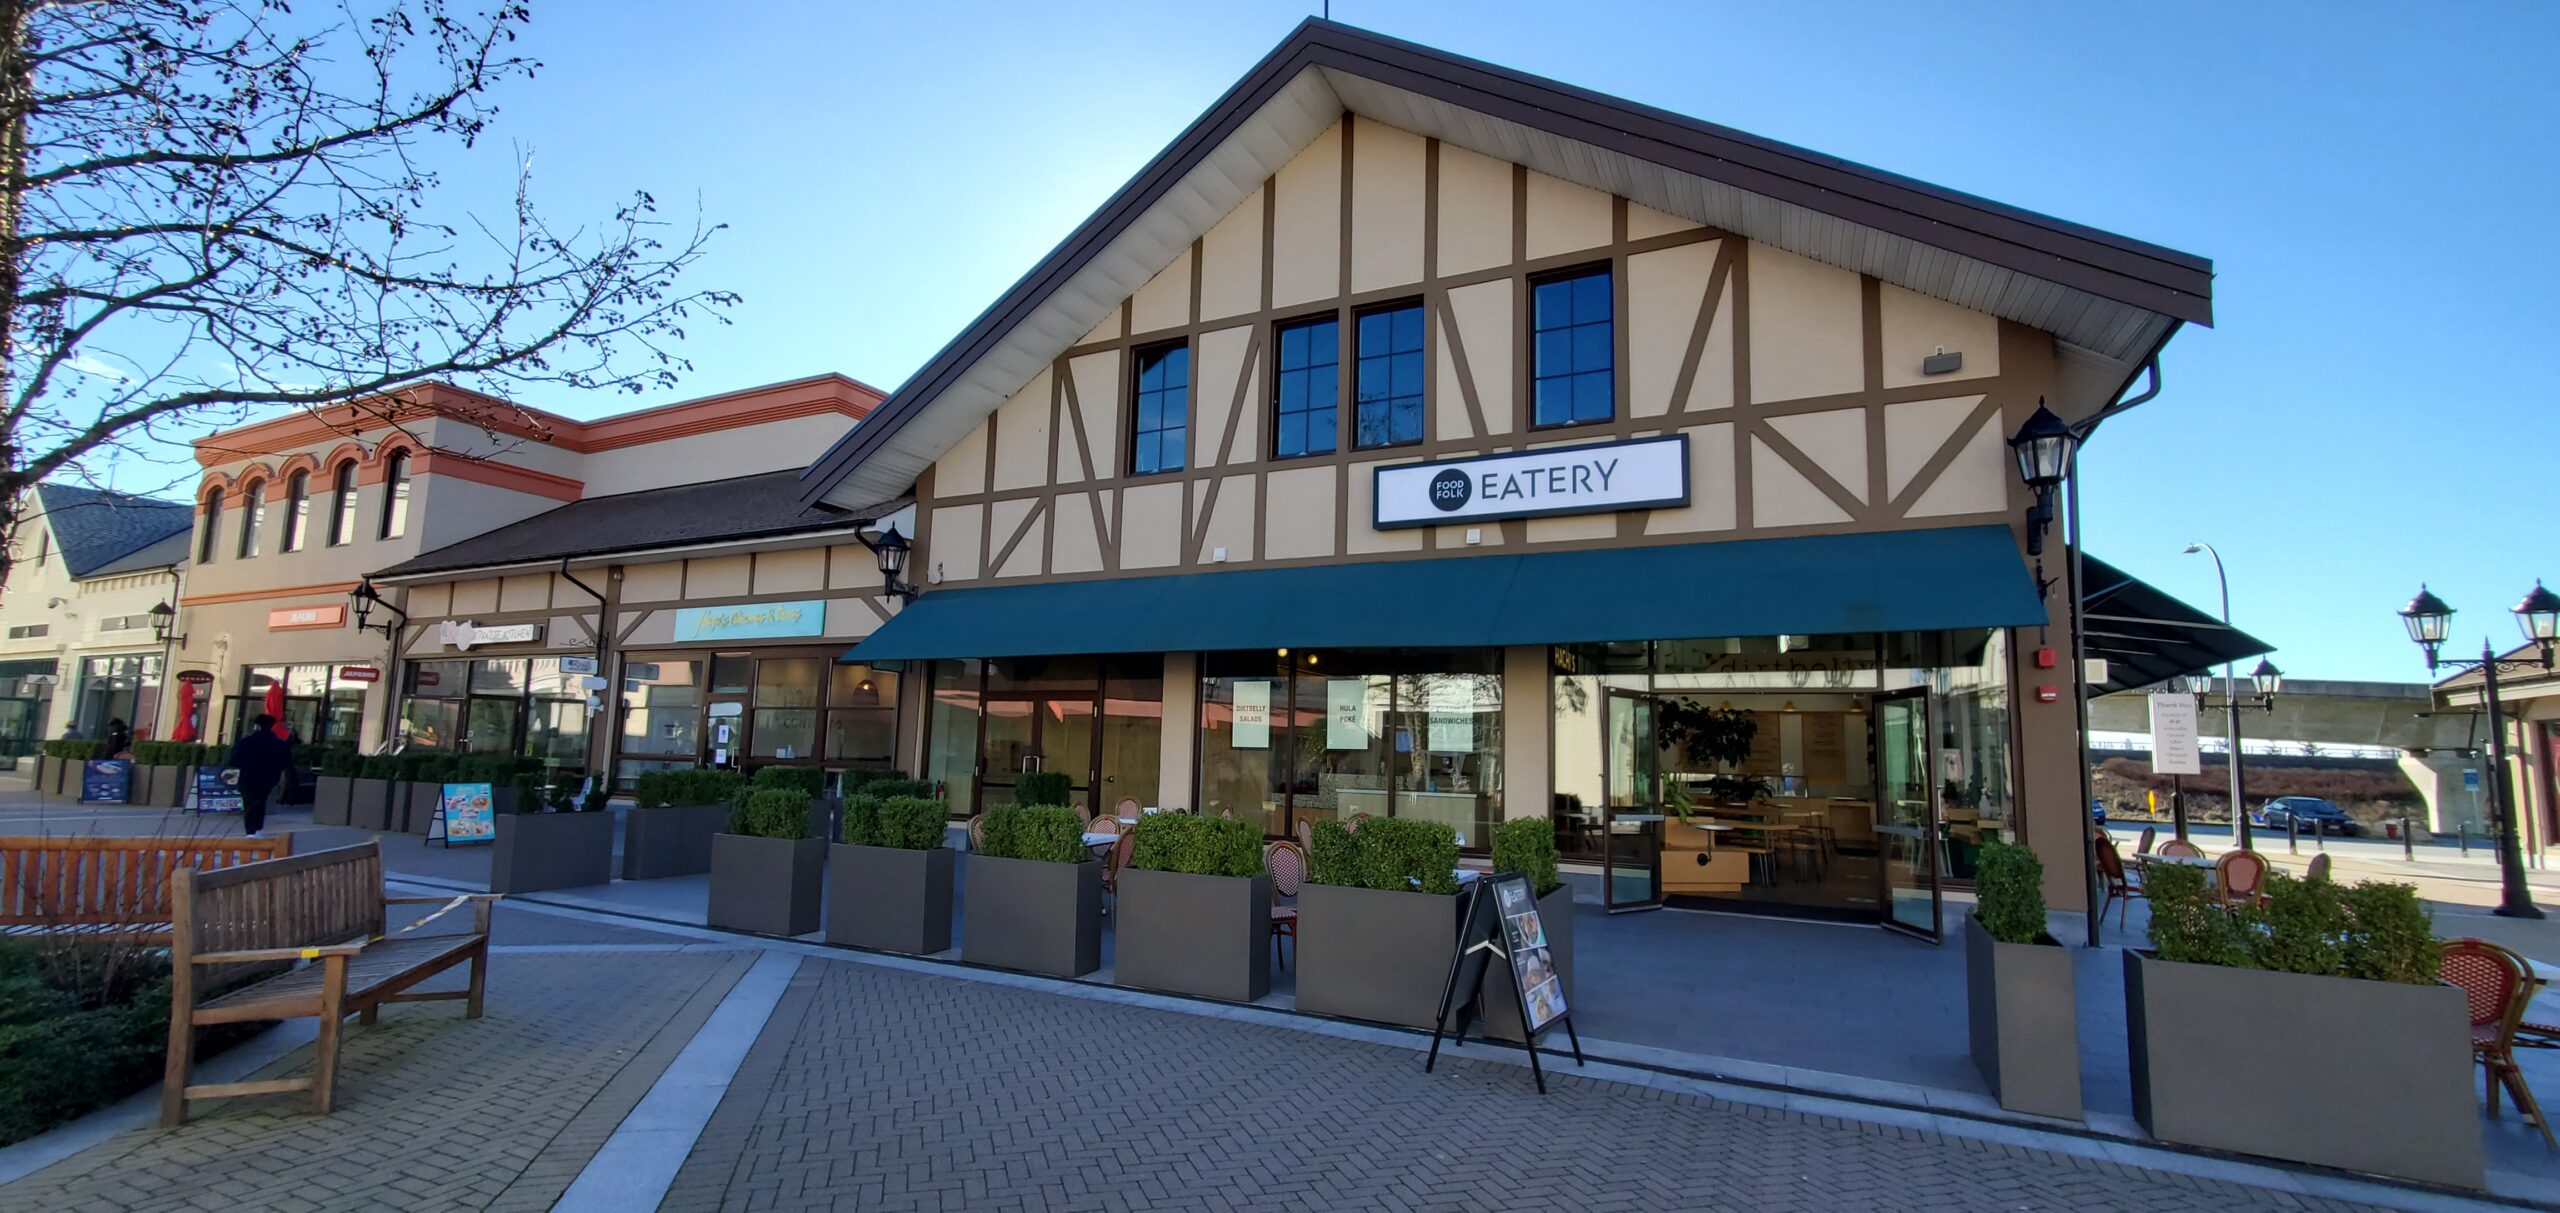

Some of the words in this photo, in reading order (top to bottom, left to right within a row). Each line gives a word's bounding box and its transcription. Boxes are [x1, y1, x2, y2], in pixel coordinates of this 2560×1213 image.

[1436, 479, 1464, 490] FOOD
[1481, 458, 1618, 500] EATERY
[1436, 489, 1464, 500] FOLK
[1339, 704, 1357, 712] HULA
[1429, 717, 1473, 725] SANDWICHES
